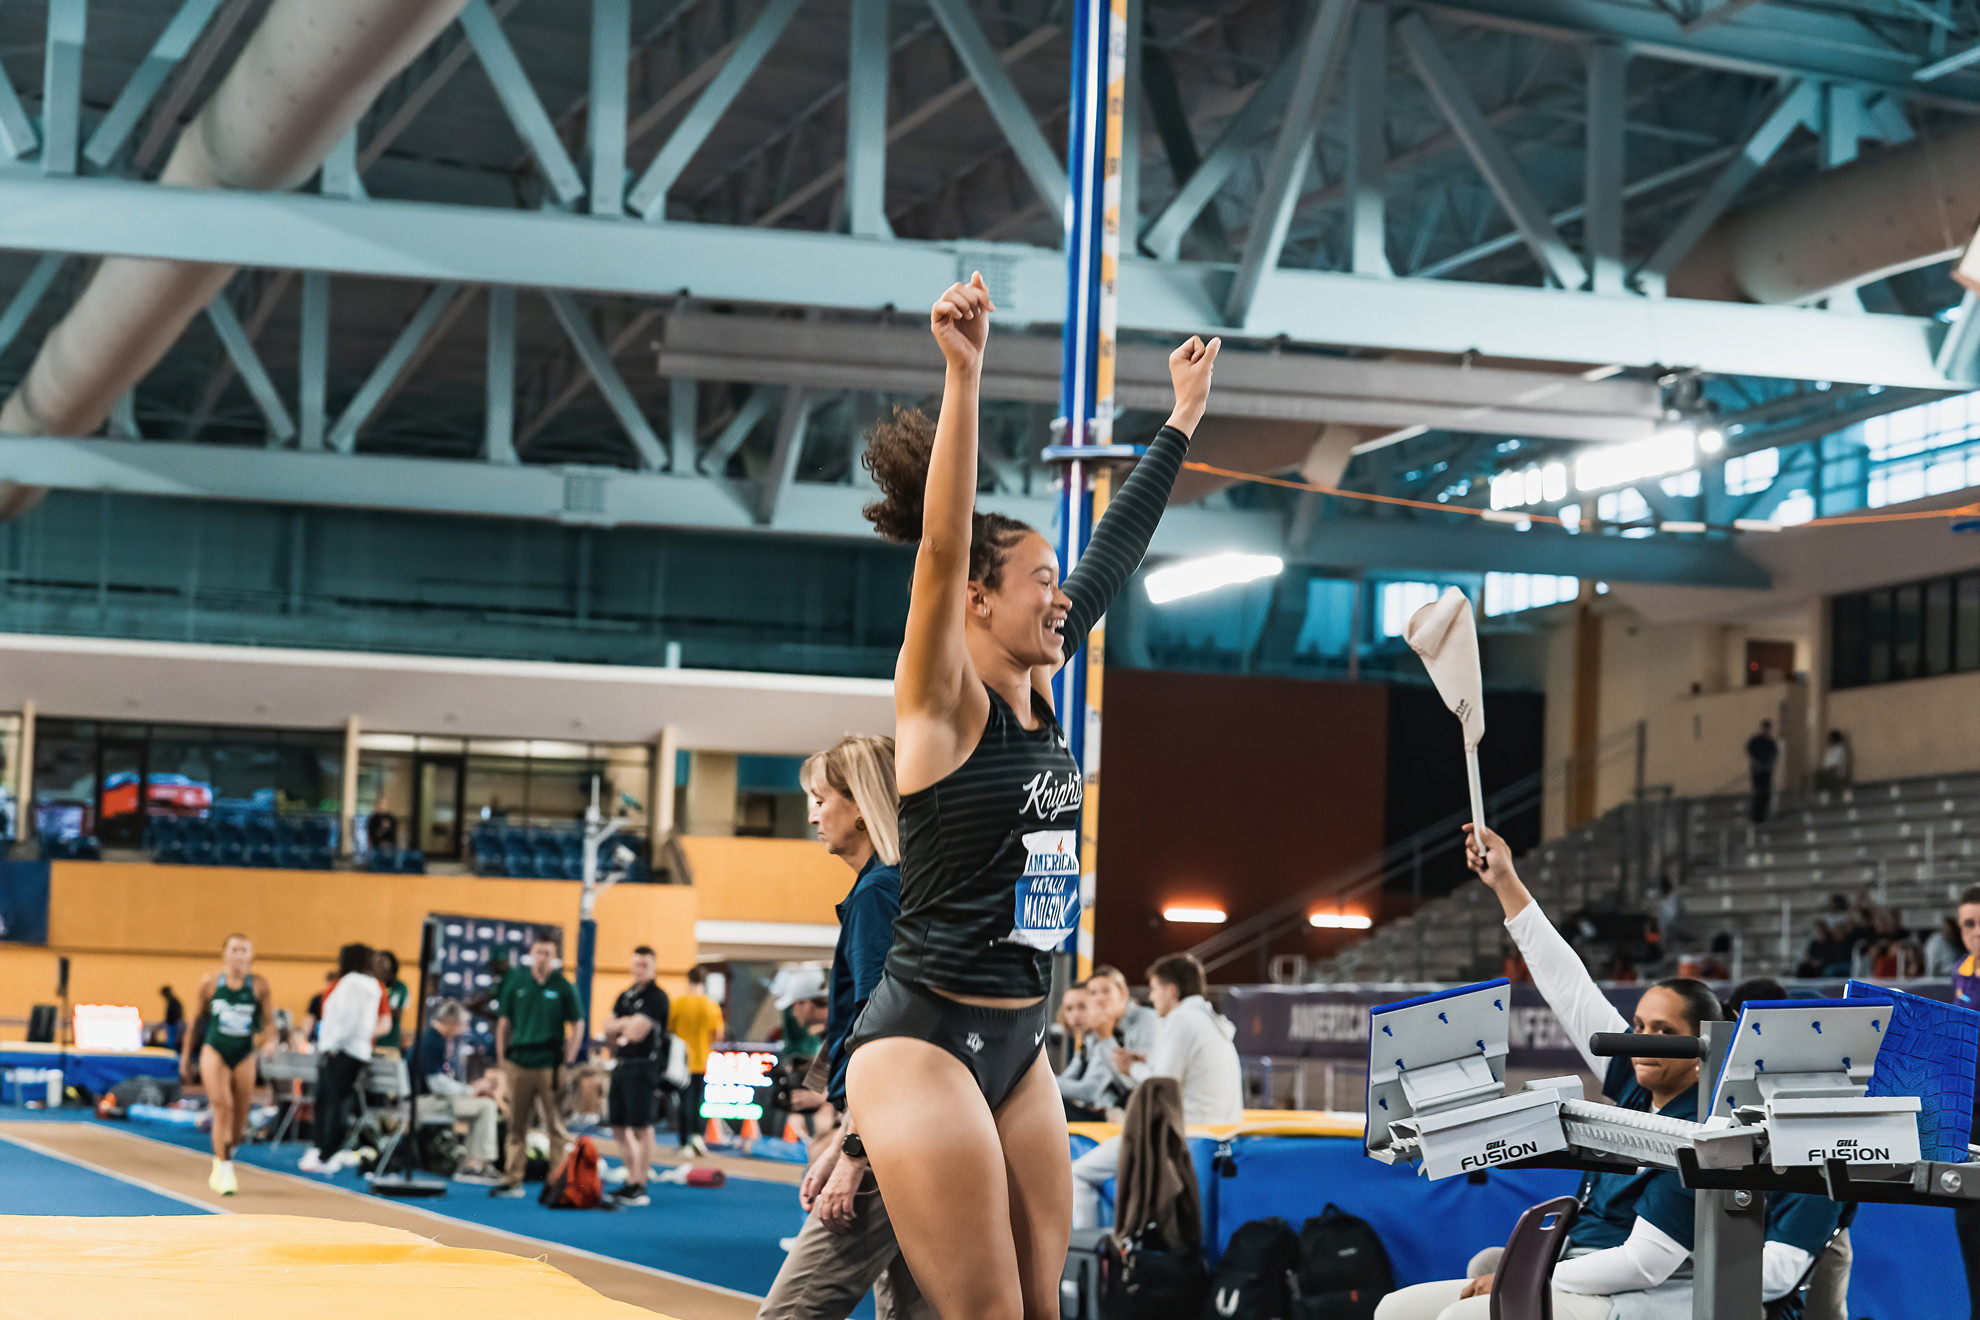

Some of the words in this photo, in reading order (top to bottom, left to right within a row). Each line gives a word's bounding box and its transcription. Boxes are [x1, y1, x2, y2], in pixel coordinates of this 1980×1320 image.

[1030, 877, 1066, 894] NATALIA
[1023, 894, 1066, 928] MADISON
[1288, 1003, 1370, 1041] AMERICA
[1486, 1139, 1507, 1151] GILL
[1836, 1139, 1859, 1147] GILL
[1461, 1140, 1538, 1171] FUSION
[1808, 1147, 1890, 1162] FUSION
